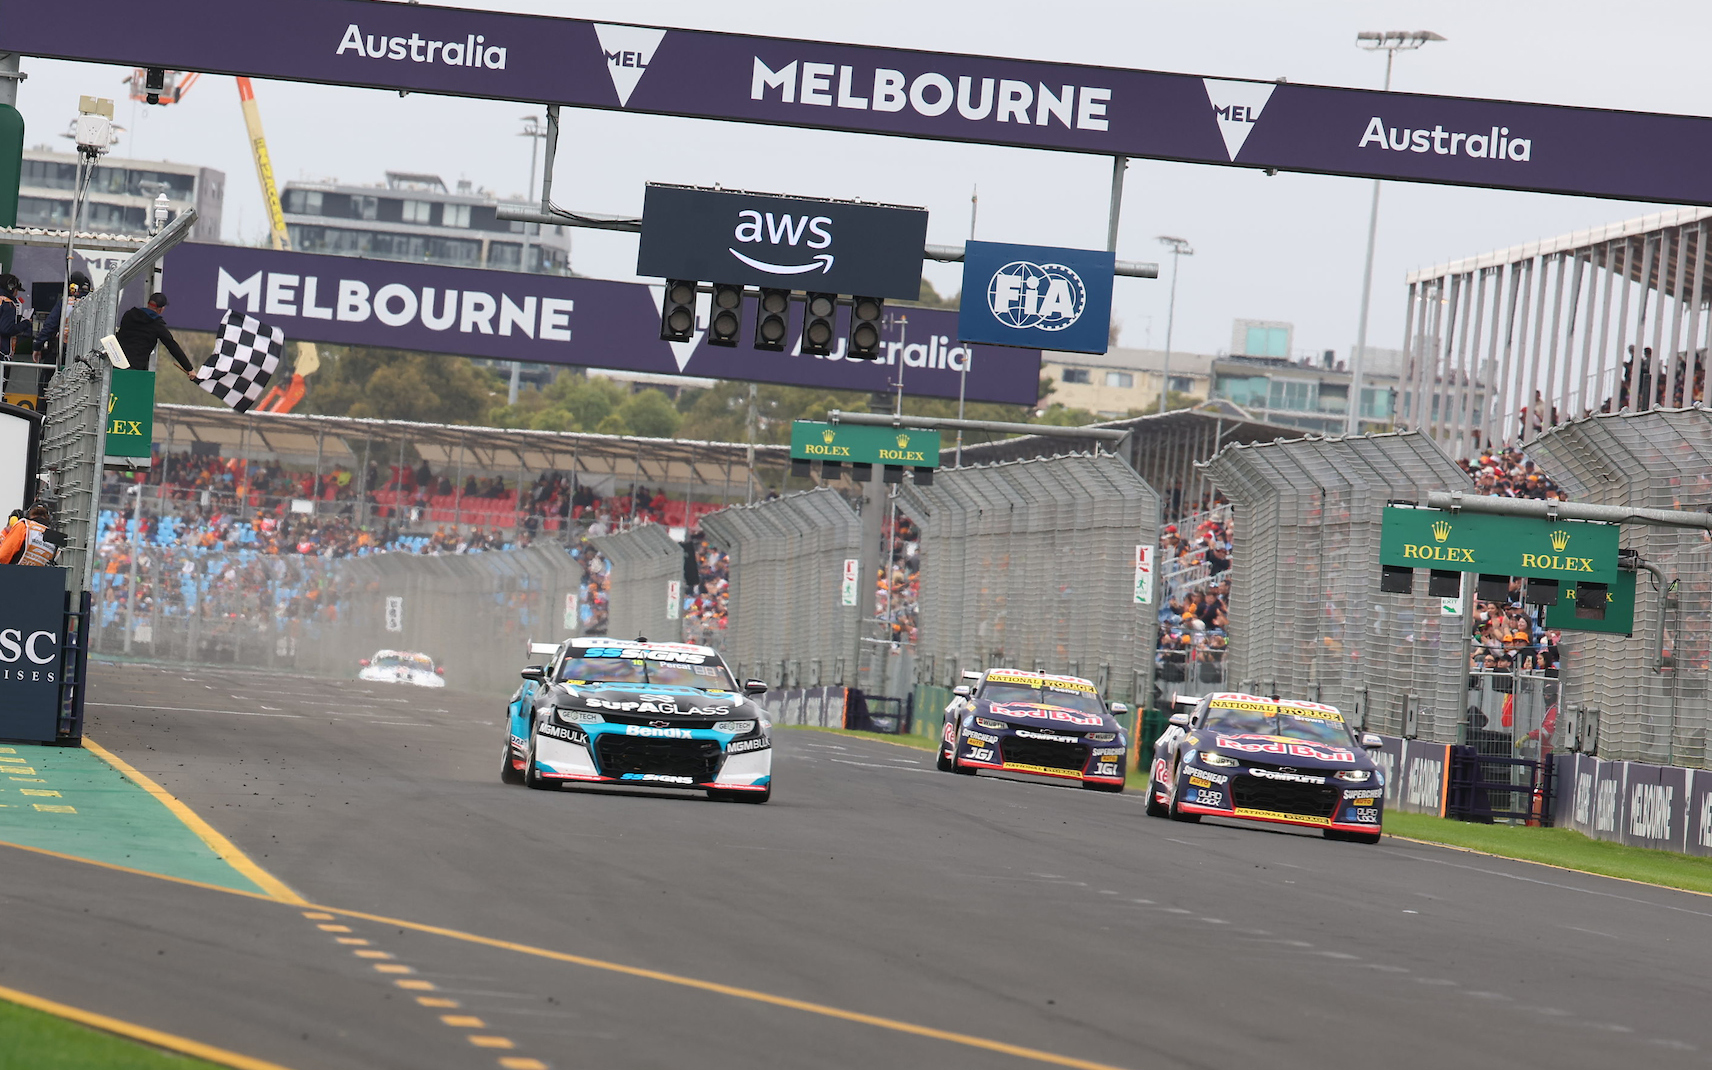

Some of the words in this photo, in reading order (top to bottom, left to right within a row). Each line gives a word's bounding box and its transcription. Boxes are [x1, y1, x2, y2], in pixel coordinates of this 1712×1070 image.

[336, 24, 507, 70] Australia
[604, 48, 648, 68] MEL
[751, 55, 1112, 132] MELBOURNE
[1213, 104, 1257, 123] MEL
[1358, 117, 1532, 162] Australia
[734, 209, 833, 250] aws
[215, 266, 574, 342] MELBOURNE
[805, 444, 850, 456] ROLEX
[879, 449, 924, 461] ROLEX
[1403, 544, 1475, 563] ROLEX
[1522, 553, 1593, 572] ROLEX
[660, 662, 691, 670] Percat
[989, 675, 1040, 685] NATIONAL
[586, 699, 730, 716] SUPAGLASS
[989, 704, 1048, 719] Red
[1049, 710, 1103, 726] Bull
[1212, 701, 1274, 712] NATIONAL
[1278, 706, 1340, 721] STORAGE
[1294, 715, 1325, 723] Brown
[626, 725, 692, 739] Bendix
[962, 728, 999, 744] SUPERCHEAP
[966, 747, 994, 761] JGI
[1216, 737, 1287, 754] Red
[1288, 744, 1356, 762] Bull
[1094, 762, 1118, 775] JGI
[1183, 765, 1228, 784] SUPERCHEAP
[1248, 768, 1326, 784] COMPLETE
[1196, 797, 1221, 806] LOCK
[1197, 789, 1222, 799] QUAD
[1237, 808, 1283, 817] NATIONAL
[1357, 808, 1378, 816] QUAD
[1357, 814, 1377, 823] LOCK
[1629, 783, 1674, 840] MELBOURNE
